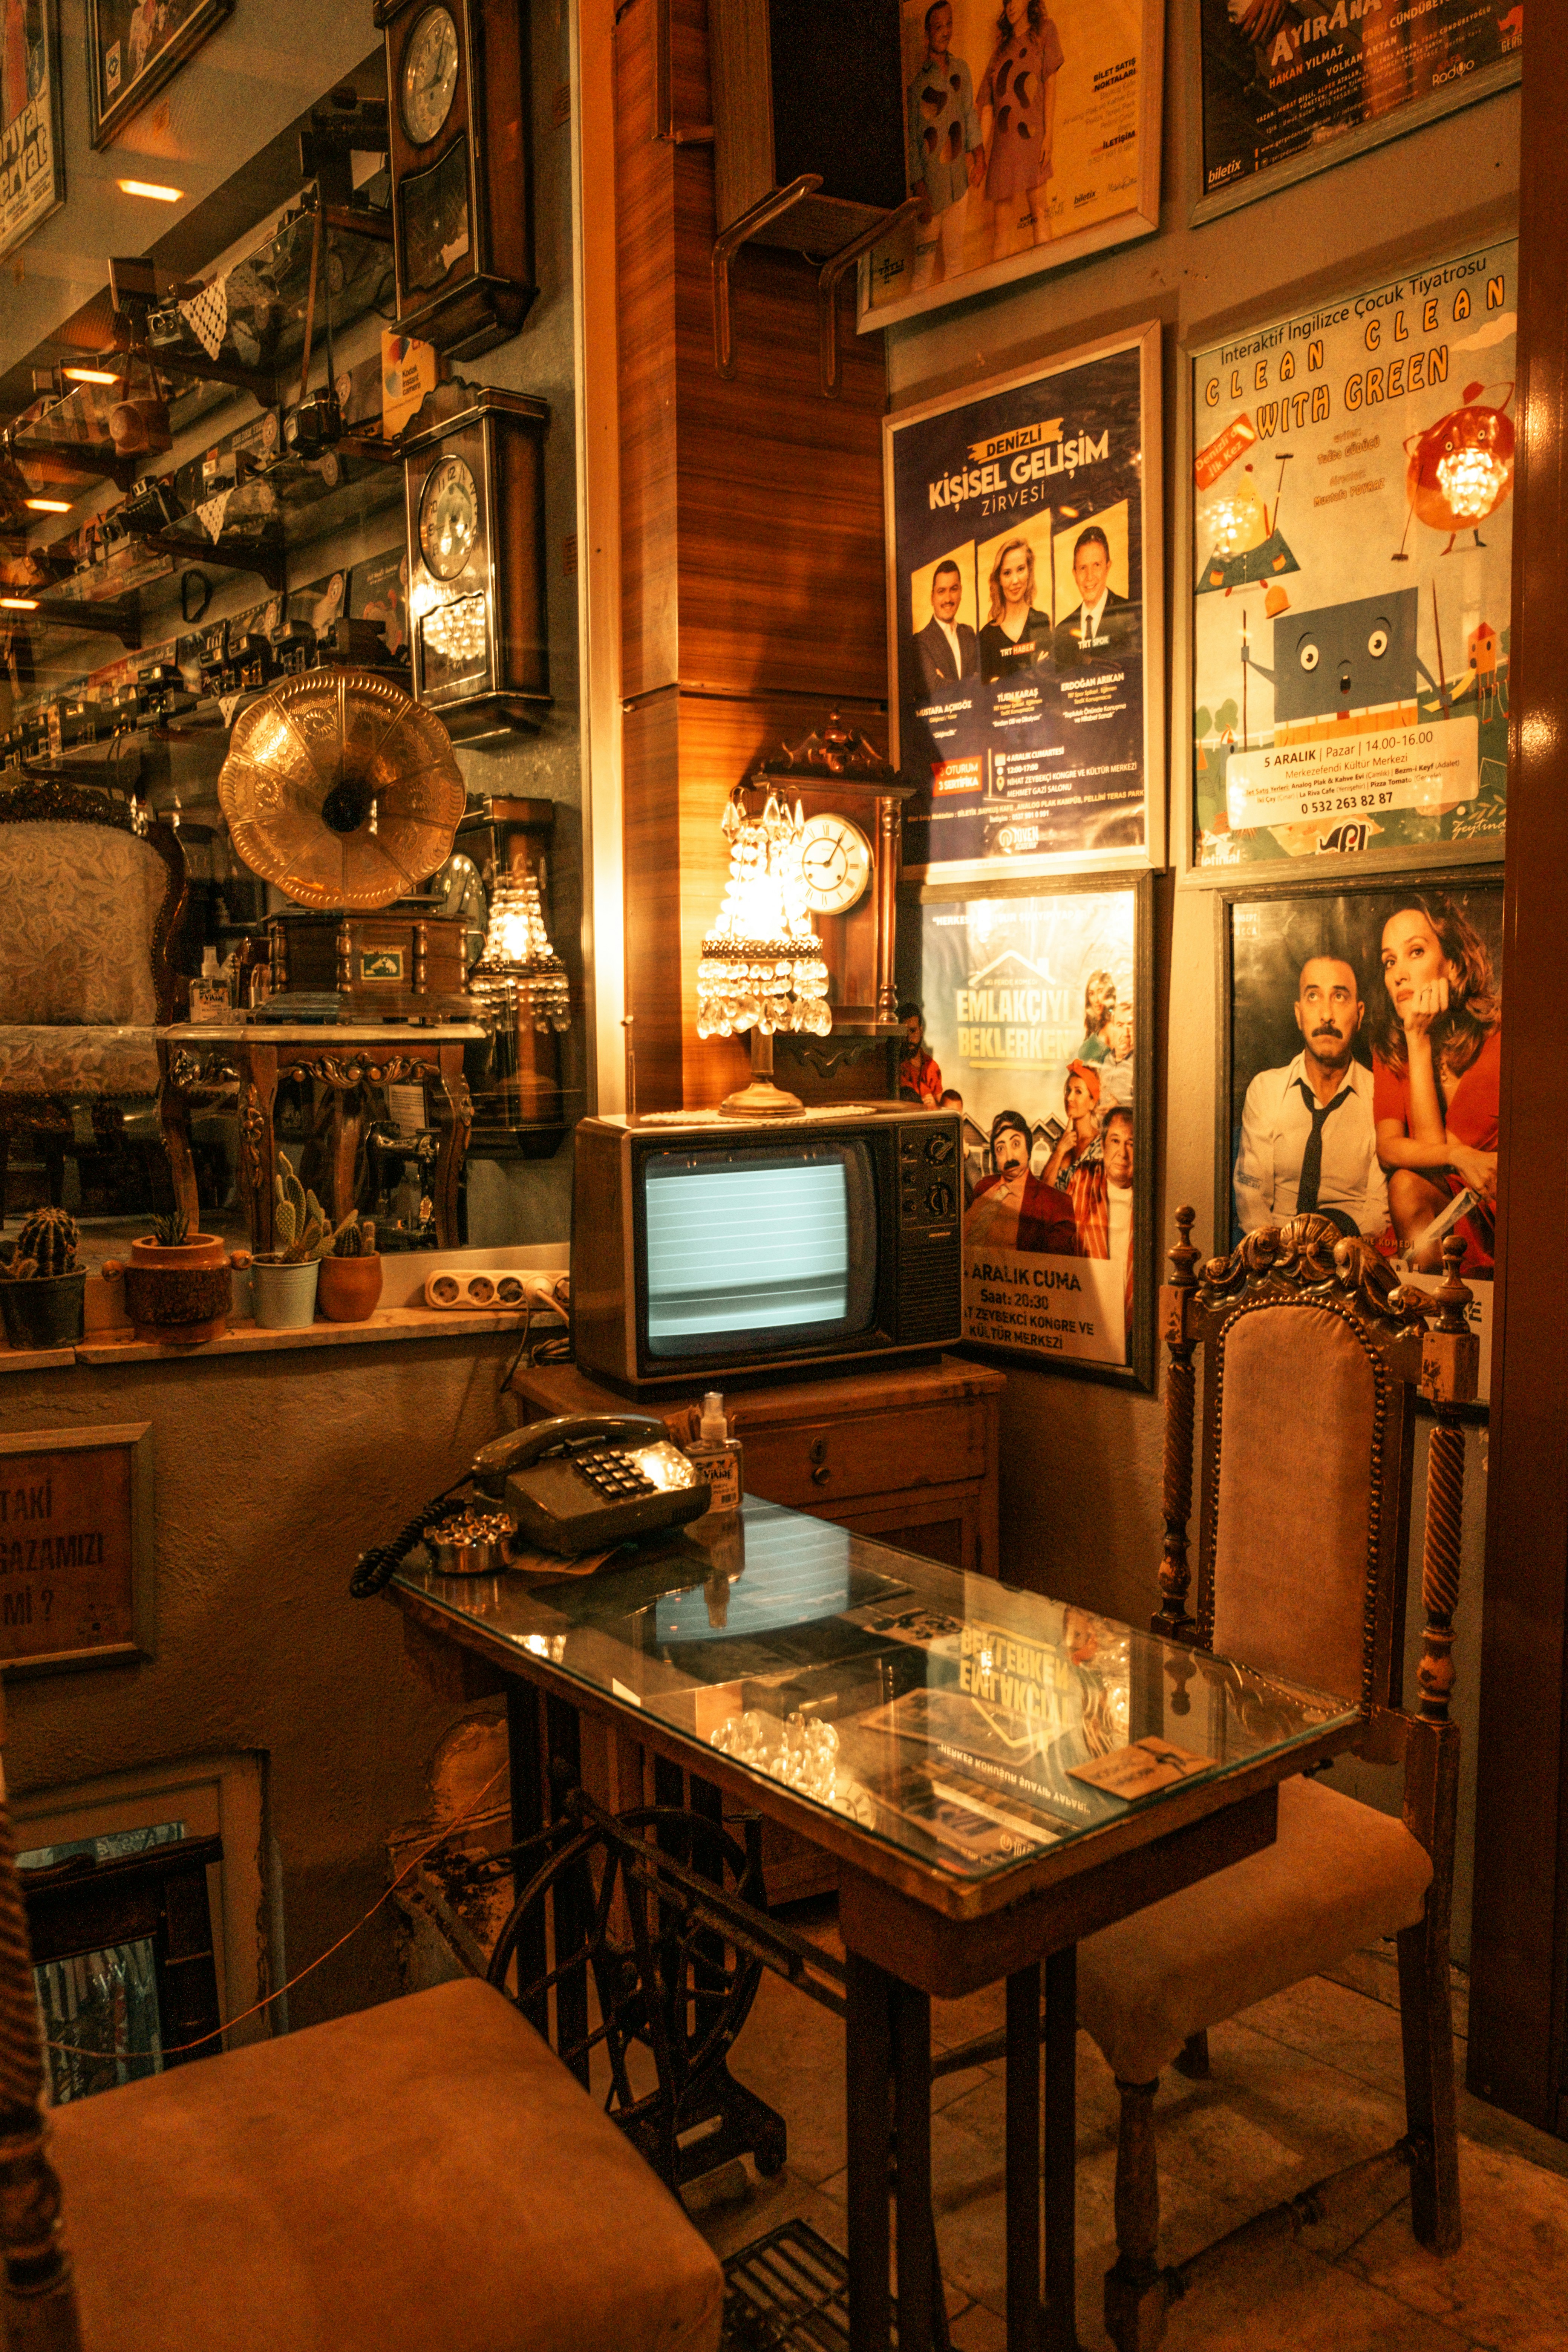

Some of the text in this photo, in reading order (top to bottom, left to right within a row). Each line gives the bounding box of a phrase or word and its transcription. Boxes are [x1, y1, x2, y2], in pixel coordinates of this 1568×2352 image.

[1269, 64, 1303, 89] HAKAN
[1306, 43, 1343, 70] YILMAZ
[1326, 52, 1363, 76] VOLKAN
[1366, 35, 1397, 57] AKTAN
[1093, 57, 1136, 82] BİLET SATIŞ
[1094, 68, 1136, 92] NOKTALARI
[1103, 130, 1136, 150] İLETİŞİM
[1208, 160, 1241, 183] biletix
[1074, 190, 1096, 204] biletix
[1288, 308, 1349, 346] İngilizce
[1354, 285, 1404, 319] Çocuk
[1409, 257, 1487, 297] Tiyatrosu
[1206, 275, 1505, 407] CLEAN CLEAN
[1257, 345, 1449, 440] WITH GREEN
[986, 424, 1042, 458] DENİZLİ
[1223, 440, 1243, 461] Kez
[929, 429, 1109, 512] KİŞİSEL GELİŞİM
[1350, 477, 1385, 497] POYRAZ
[982, 481, 1045, 517] ZİRVESİ
[1000, 643, 1034, 657] TRT HABER
[1078, 640, 1091, 649] TRT
[1014, 688, 1038, 698] KARAŞ
[1061, 672, 1124, 692] ERDOĞAN ARIKAN
[916, 699, 972, 717] MUSTAFA AÇIKGÖZ
[1011, 752, 1031, 761] ARALIK
[1032, 746, 1064, 759] CUMARTESİ
[1265, 730, 1433, 767] 5 ARALIK Pazar 14.00-16.00
[945, 763, 978, 775] OTURUM
[1007, 777, 1024, 786] NİHAT
[1025, 772, 1051, 783] ZEYBEKÇİ
[1053, 770, 1076, 780] KONGRE
[1086, 766, 1109, 776] KÜLTÜR
[1111, 761, 1136, 772] MERKEZİ
[1286, 753, 1408, 779] Merkezefendi Kültür Merkezi
[1291, 782, 1312, 790] Analog
[1419, 763, 1434, 772] Keyf
[1435, 760, 1460, 769] (Adalet)
[939, 776, 979, 790] 3 SERTİFİKA
[1007, 783, 1072, 798] MEHMET GAZİ SALONU
[1017, 801, 1040, 810] ANALOG
[1041, 799, 1056, 807] PLAK
[1084, 792, 1106, 803] PELLİNİ
[1107, 791, 1127, 800] TERAS
[1128, 789, 1144, 798] PARK
[1302, 792, 1393, 814] 0 532 263 82 87
[957, 989, 1069, 1026] EMLAKÇIYI
[958, 1027, 1070, 1060] BEKLERKEN
[972, 1263, 1082, 1292] ARALIK CUMA
[981, 1289, 1049, 1310] Saat: 20:30
[1030, 1313, 1076, 1333] KONGRE
[1079, 1321, 1094, 1336] VE
[969, 1323, 1063, 1350] KÜLTÜR MERKEZİ
